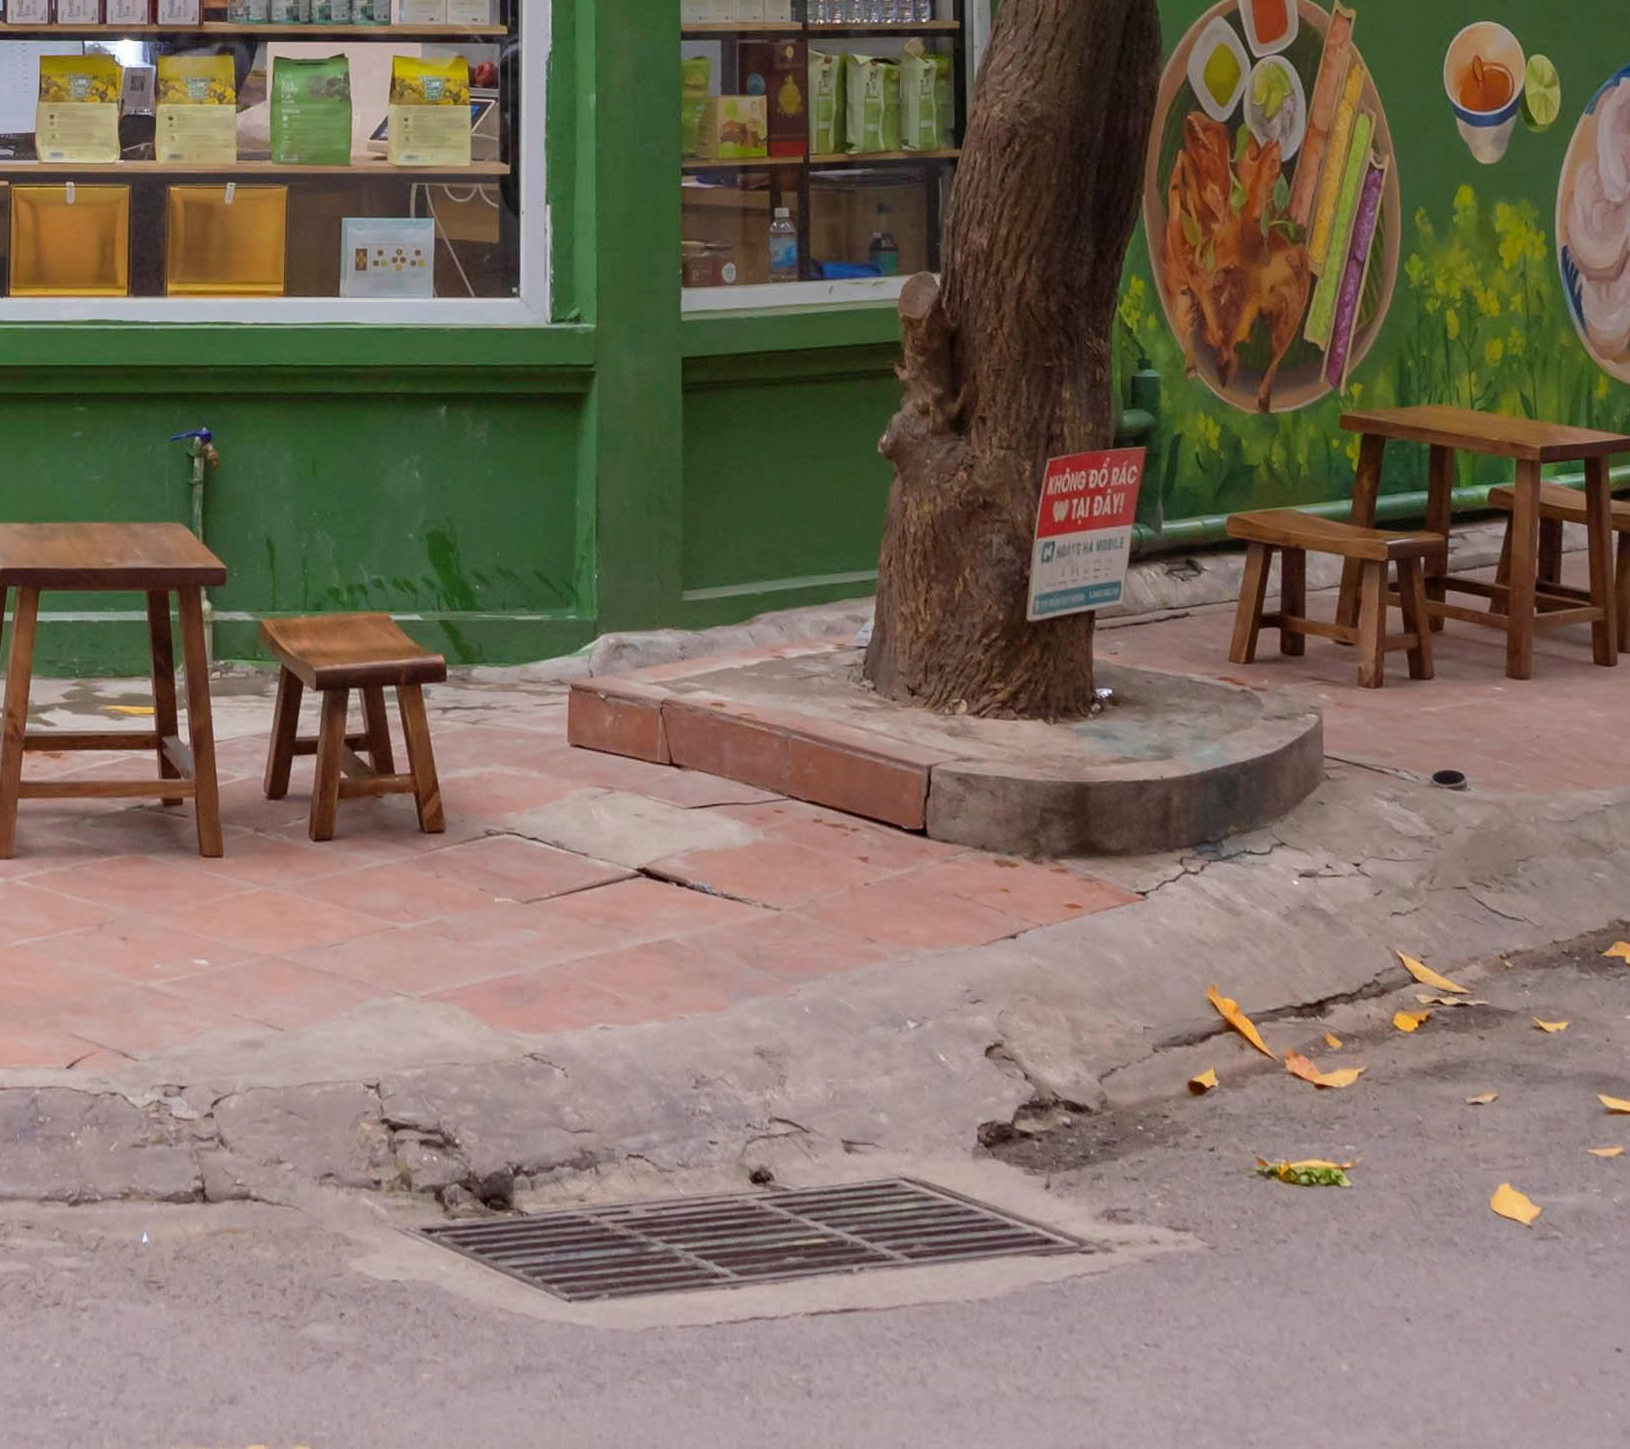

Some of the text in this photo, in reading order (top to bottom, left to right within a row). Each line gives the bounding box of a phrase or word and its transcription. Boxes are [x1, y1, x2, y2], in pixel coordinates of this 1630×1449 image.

[1047, 457, 1138, 495] KHÔNG ĐỔ RÁC
[1071, 488, 1125, 526] TẠI ĐÂY!
